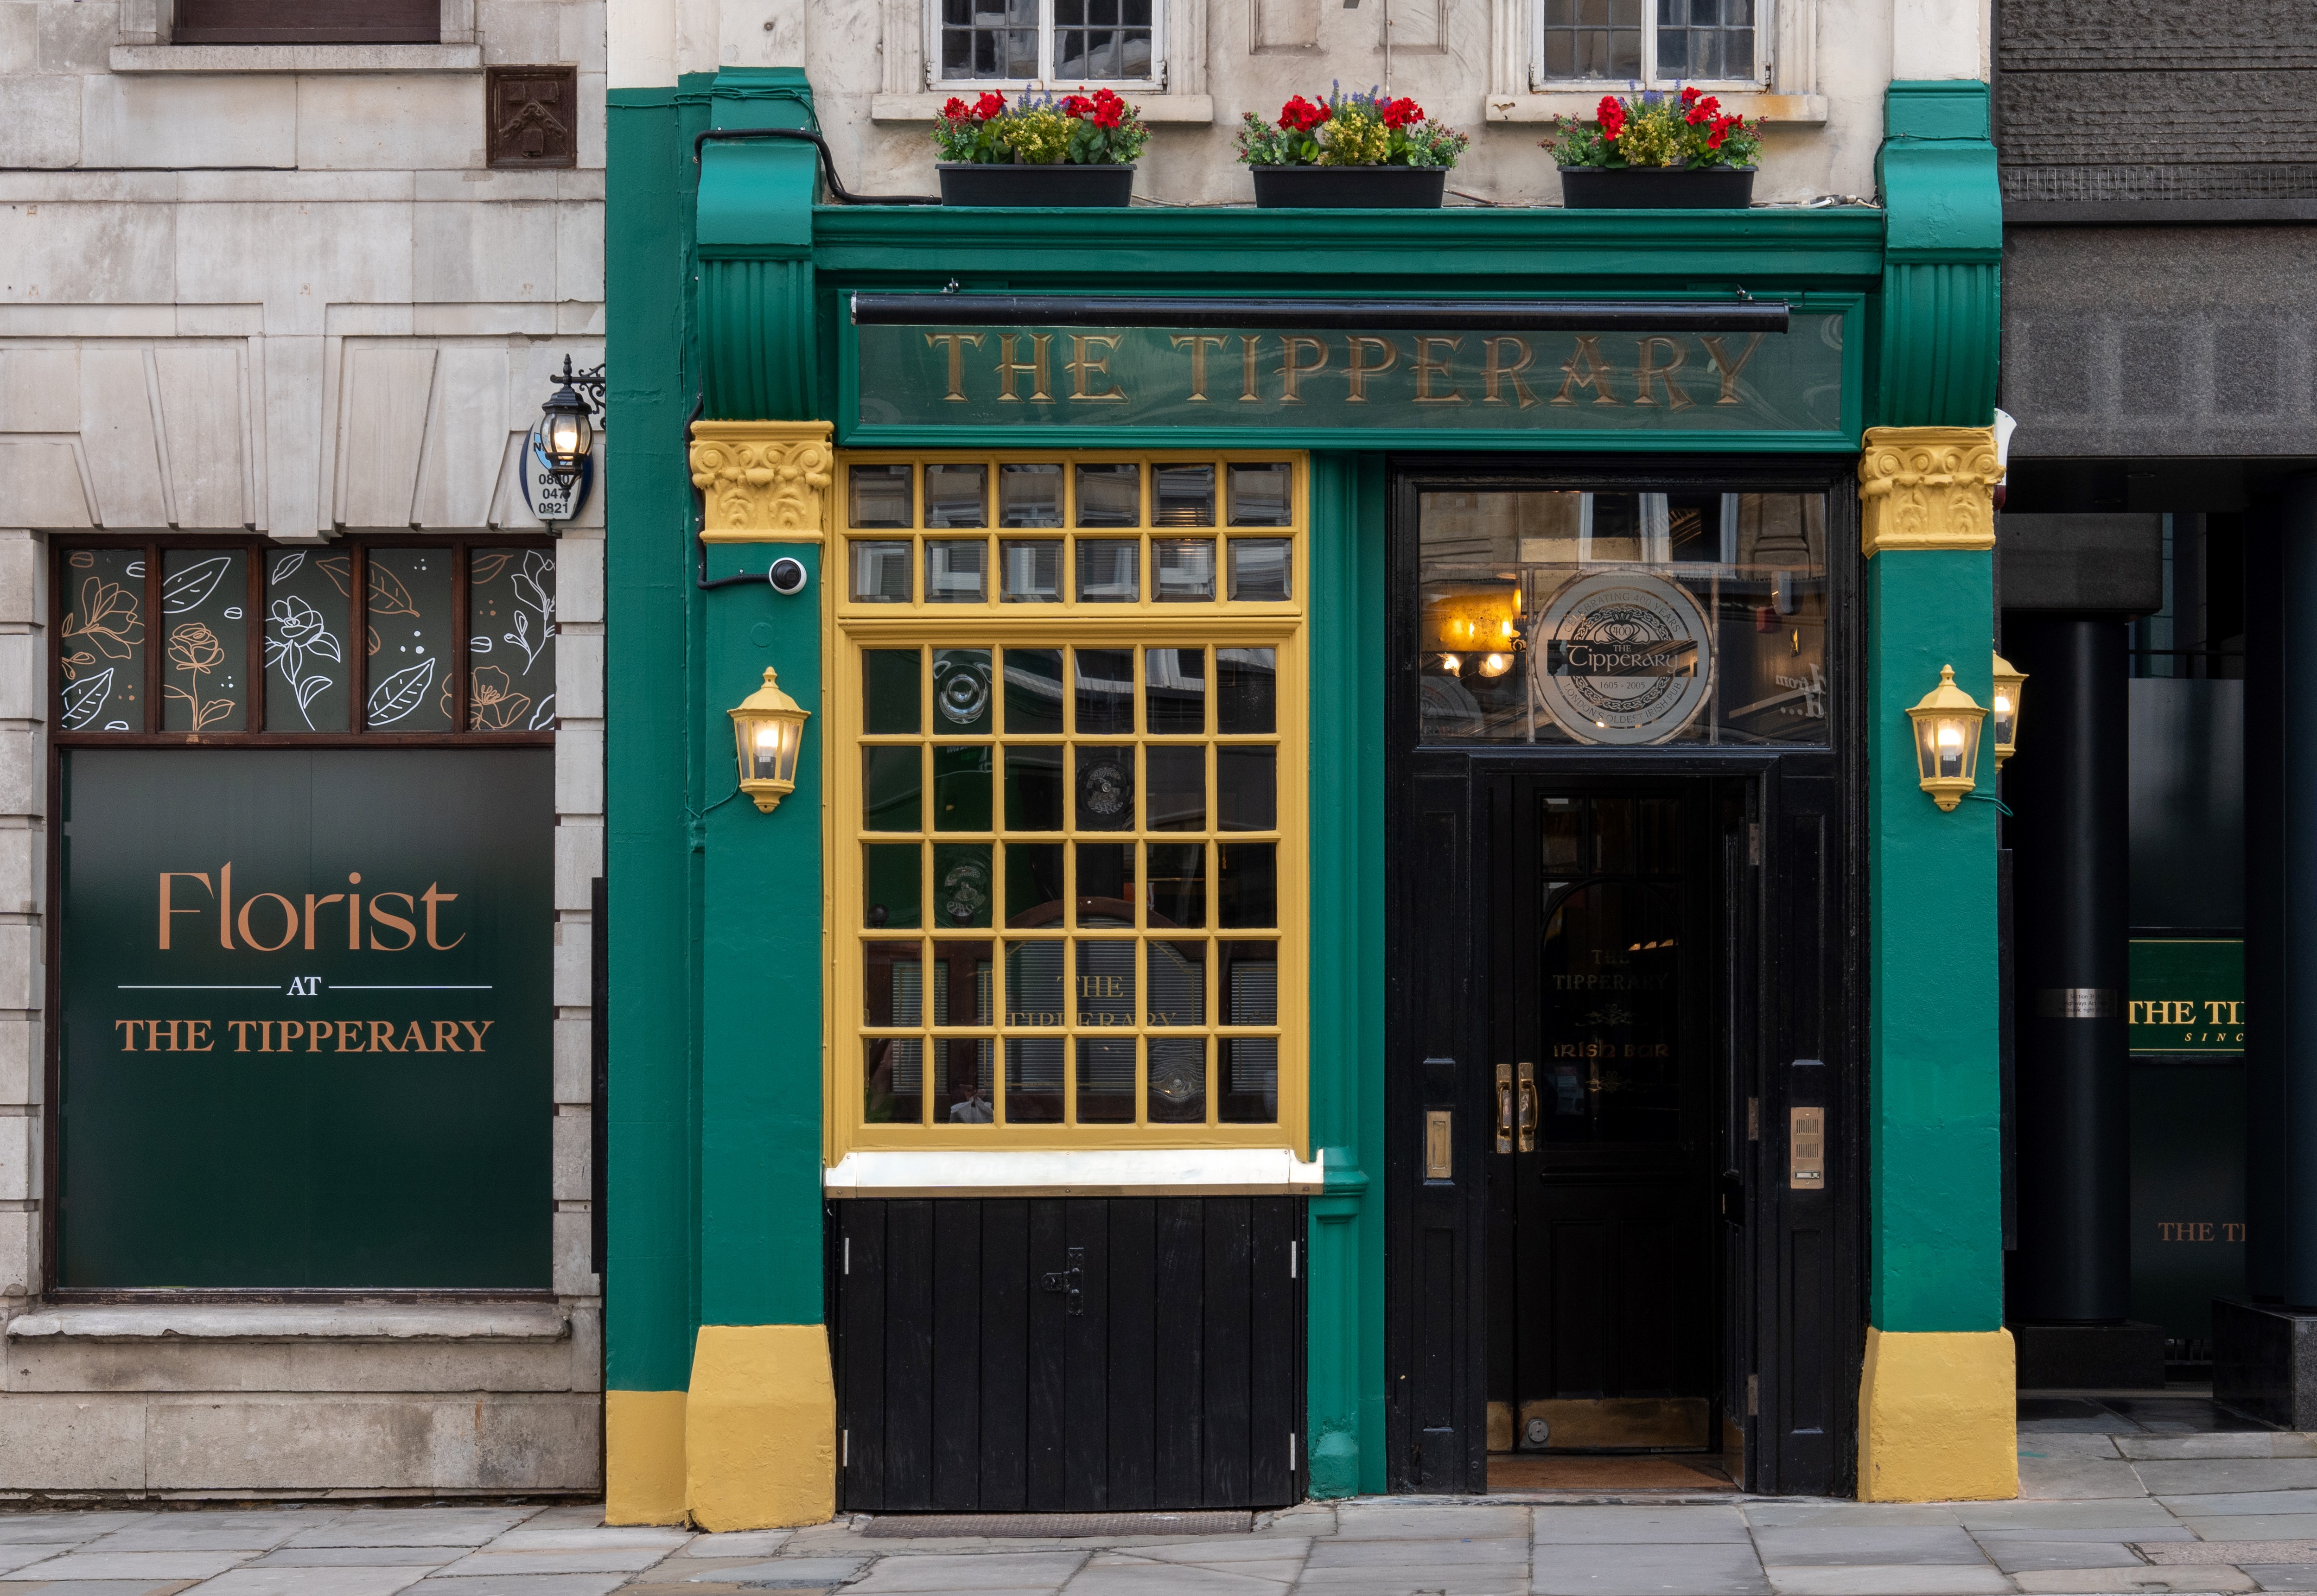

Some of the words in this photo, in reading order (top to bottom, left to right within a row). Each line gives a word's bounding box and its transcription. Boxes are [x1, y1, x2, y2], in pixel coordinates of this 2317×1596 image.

[924, 332, 1130, 404] THE
[1168, 332, 1767, 413] TIPPERARY
[1564, 592, 1630, 633] CELEBRATING
[1633, 594, 1651, 607] 400
[1654, 603, 1681, 633] YEARS
[1613, 626, 1631, 636] 400
[1564, 683, 1604, 719] LONDON'S
[1606, 713, 1643, 724] OLDEST
[1645, 699, 1669, 718] IRISH
[1667, 682, 1682, 700] PUB
[159, 861, 466, 951] Florist
[286, 976, 322, 996] AT
[2129, 1001, 2196, 1025] THE
[115, 1020, 215, 1051] THE
[228, 1021, 495, 1052] TIPPERARY
[2158, 1222, 2215, 1242] THE
